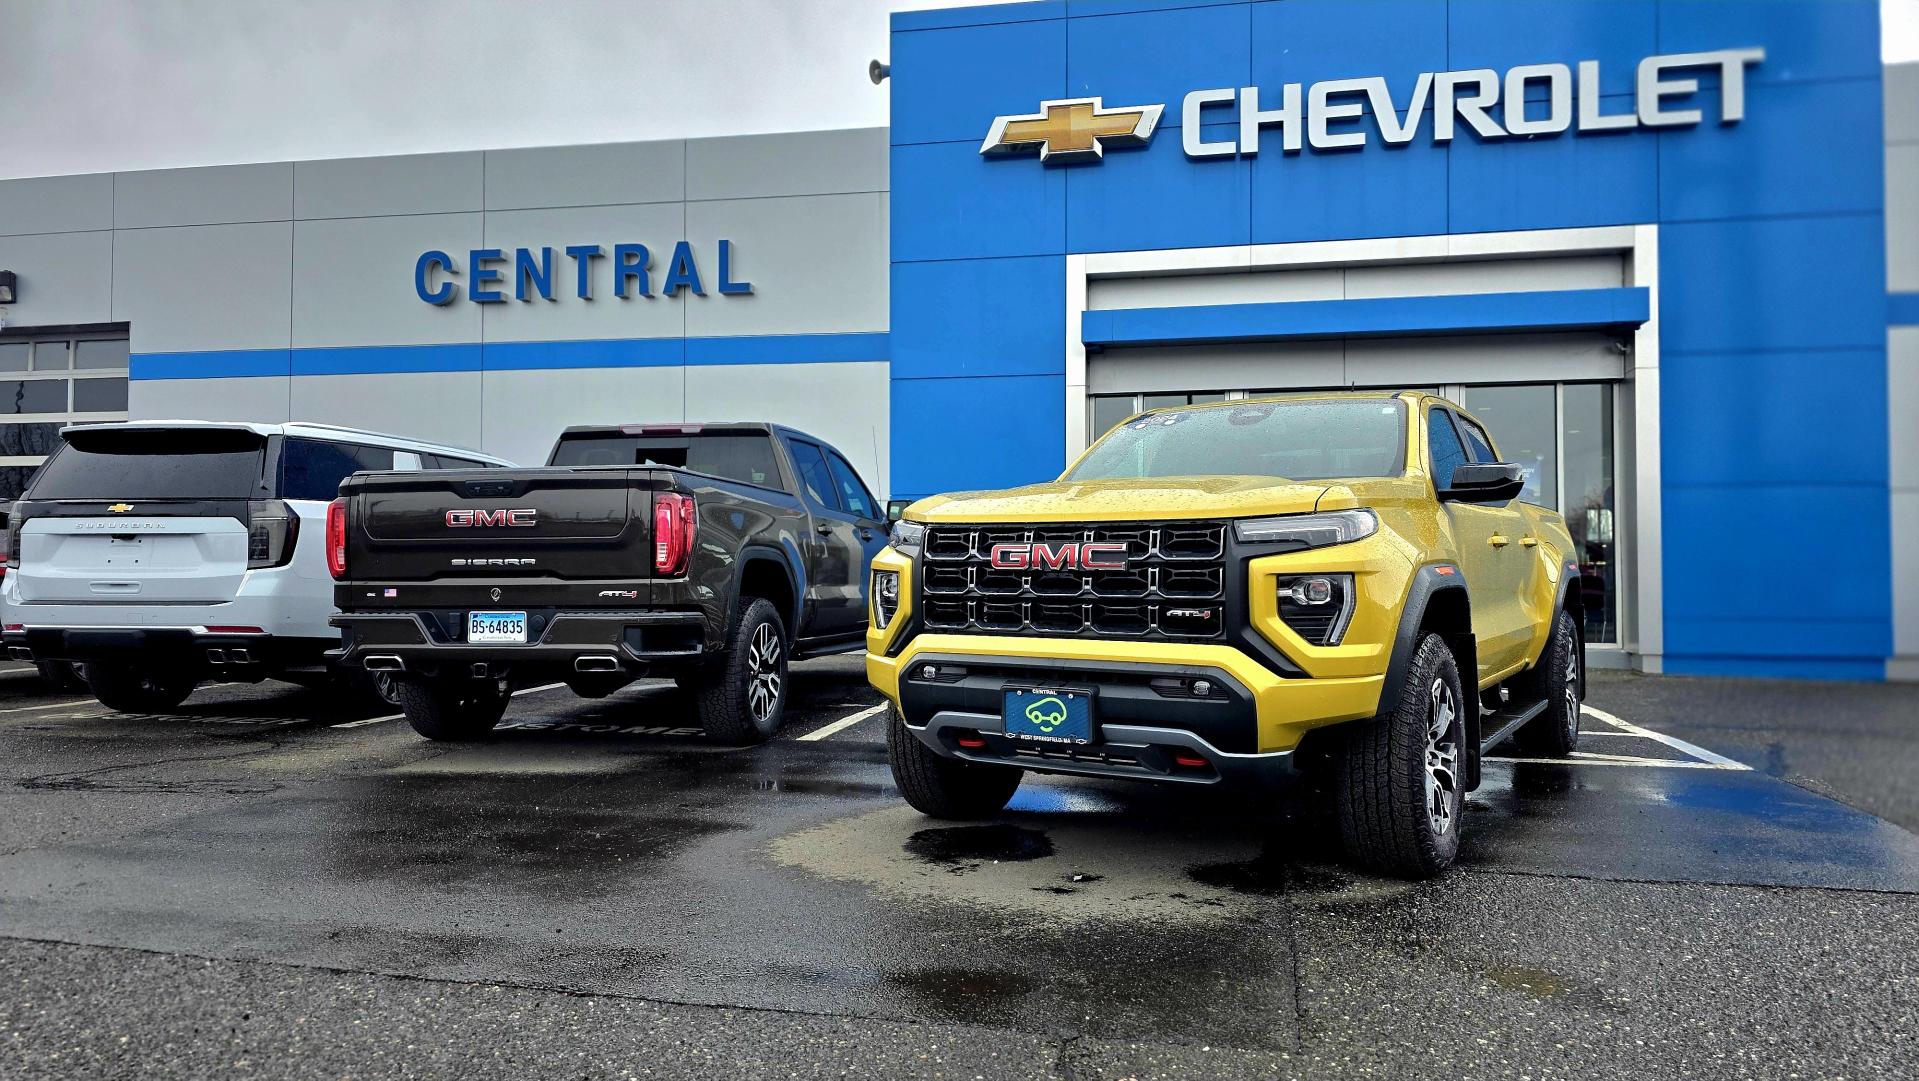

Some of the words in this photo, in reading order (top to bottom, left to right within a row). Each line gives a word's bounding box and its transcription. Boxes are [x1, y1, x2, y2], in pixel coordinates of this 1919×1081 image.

[1182, 48, 1766, 157] CHEVROLET
[415, 239, 755, 306] CENTRAL
[445, 508, 537, 527] GMC
[451, 558, 536, 566] SIERRA
[991, 542, 1127, 571] GMC
[599, 590, 638, 599] AT4
[1032, 688, 1058, 696] CENTRAL
